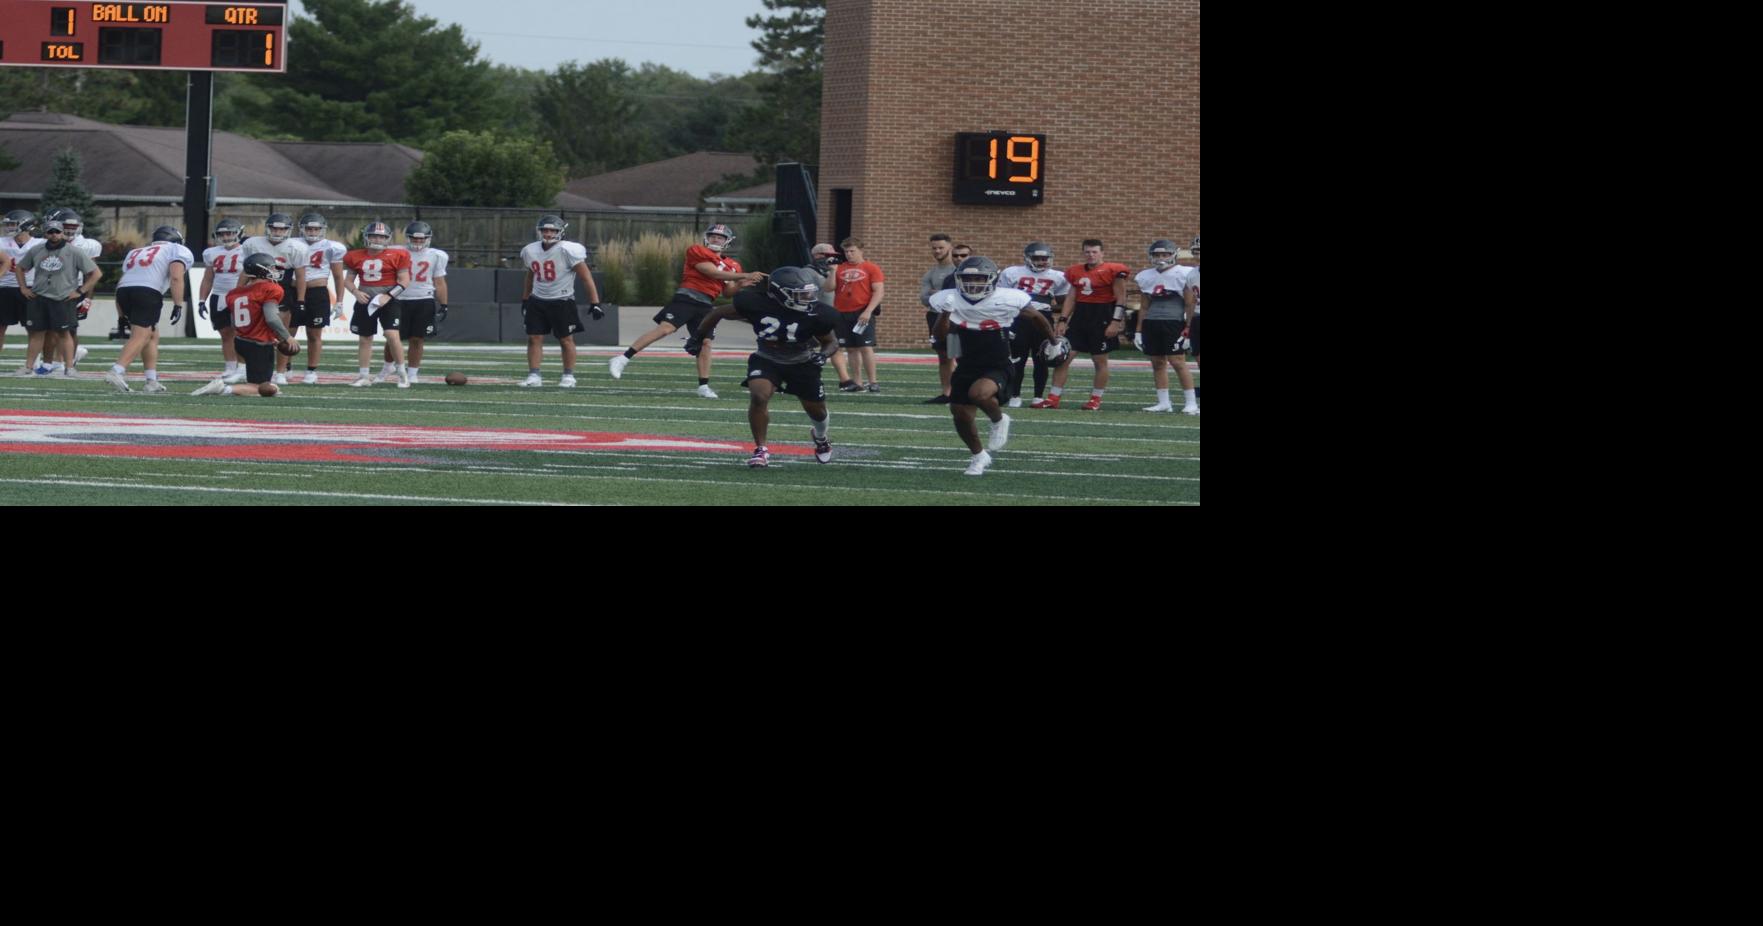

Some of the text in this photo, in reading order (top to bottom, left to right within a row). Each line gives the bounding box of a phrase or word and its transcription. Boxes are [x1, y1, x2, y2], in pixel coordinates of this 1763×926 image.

[67, 9, 74, 35] 1
[92, 4, 168, 23] BALL ON
[224, 7, 258, 25] QTR
[47, 45, 80, 59] TOL
[264, 33, 274, 66] 1
[988, 136, 1039, 183] 19
[213, 254, 239, 273] 41
[309, 250, 324, 269] 4
[362, 258, 383, 282] 8
[1018, 276, 1055, 297] 87
[234, 296, 251, 328] 6
[758, 316, 799, 343] 21
